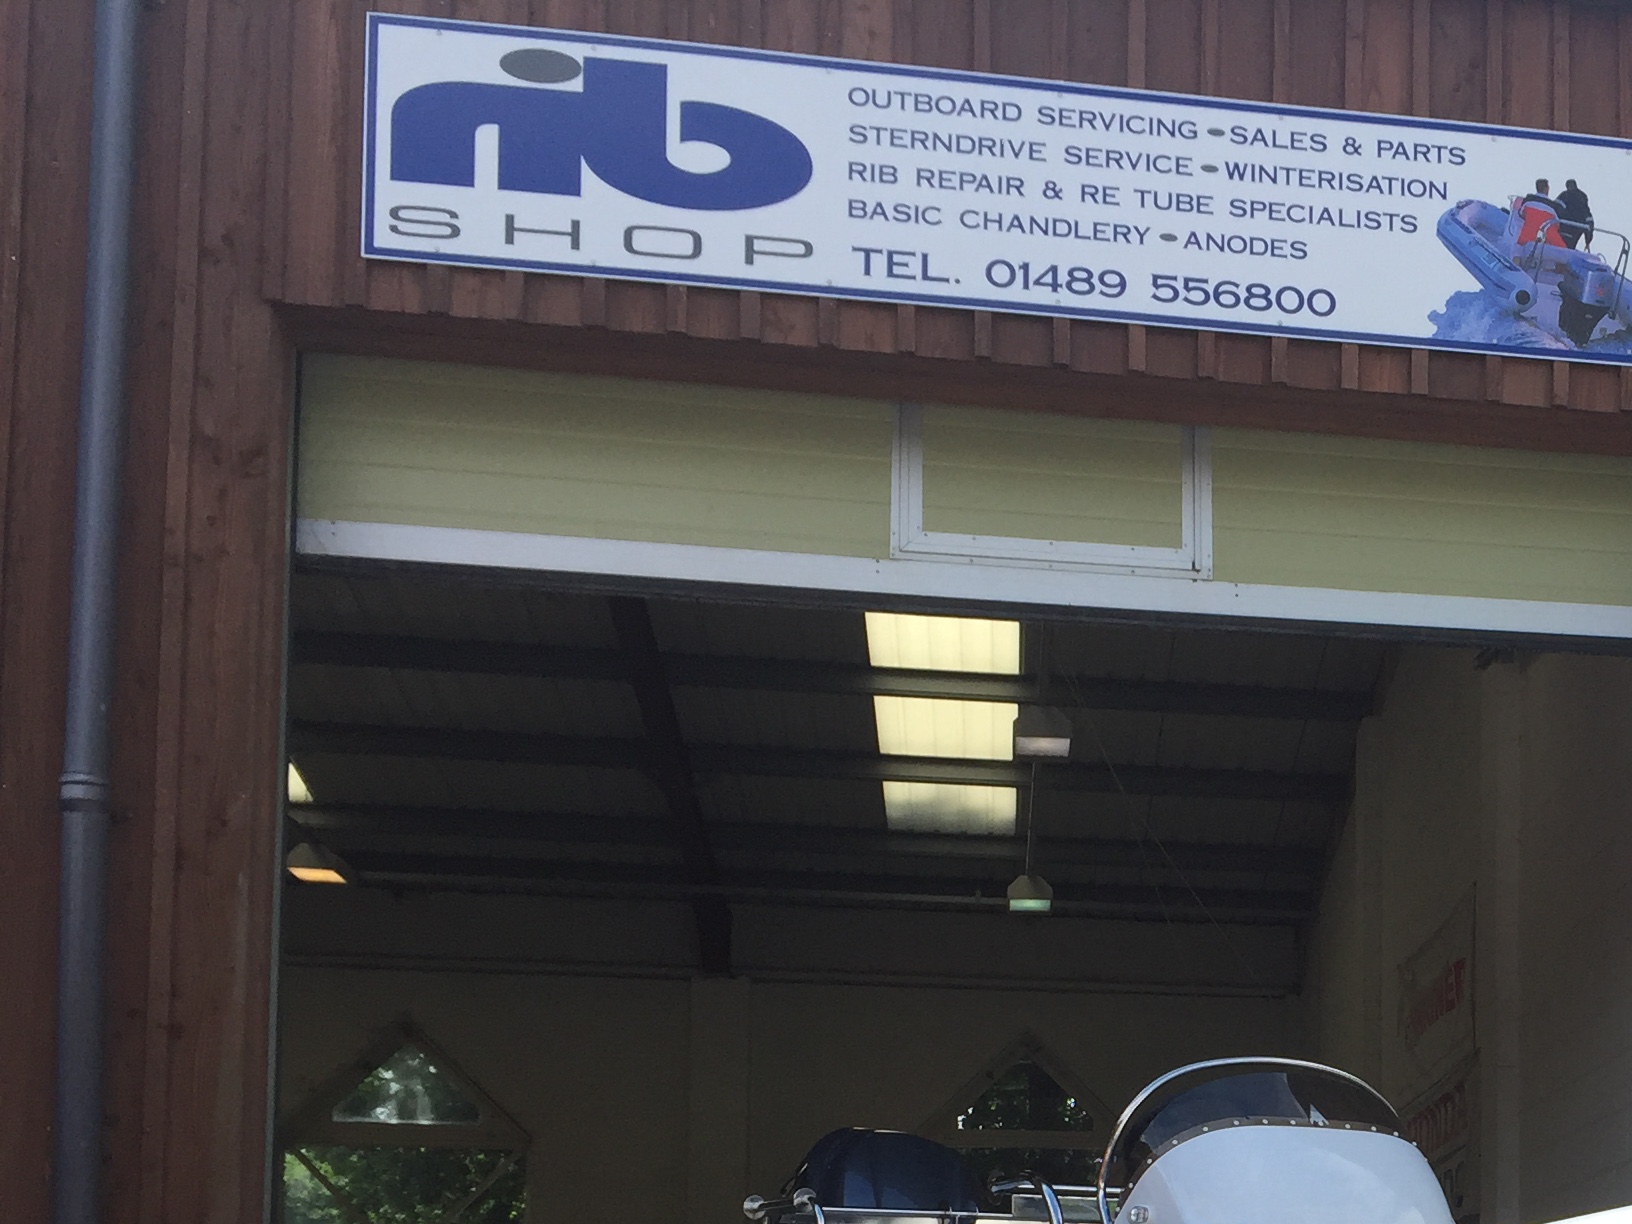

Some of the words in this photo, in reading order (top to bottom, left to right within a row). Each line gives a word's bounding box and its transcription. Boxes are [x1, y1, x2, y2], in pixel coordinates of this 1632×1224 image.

[390, 48, 813, 211] rib
[848, 87, 1022, 122] OUTBOARD
[1037, 106, 1198, 140] SERVICING
[1229, 125, 1328, 152] SALES
[1343, 137, 1362, 156] &
[1377, 139, 1466, 166] PARTS
[849, 124, 1047, 162] STERNDRIVE
[1064, 146, 1193, 177] SERVICE
[1225, 161, 1448, 200] WINTERISATION
[848, 161, 898, 185] RIB
[916, 167, 1025, 197] REPAIR
[1042, 180, 1063, 200] &
[1081, 183, 1120, 206] RE
[1134, 188, 1213, 215] TUBE
[1229, 199, 1418, 233] SPECIALISTS
[848, 198, 942, 226] BASIC
[959, 209, 1151, 246] CHANDLERY
[1183, 231, 1308, 260] ANODES
[388, 205, 814, 266] SHOP
[851, 245, 961, 285] TEL.
[985, 259, 1127, 298] 01489
[1151, 273, 1337, 317] 556800
